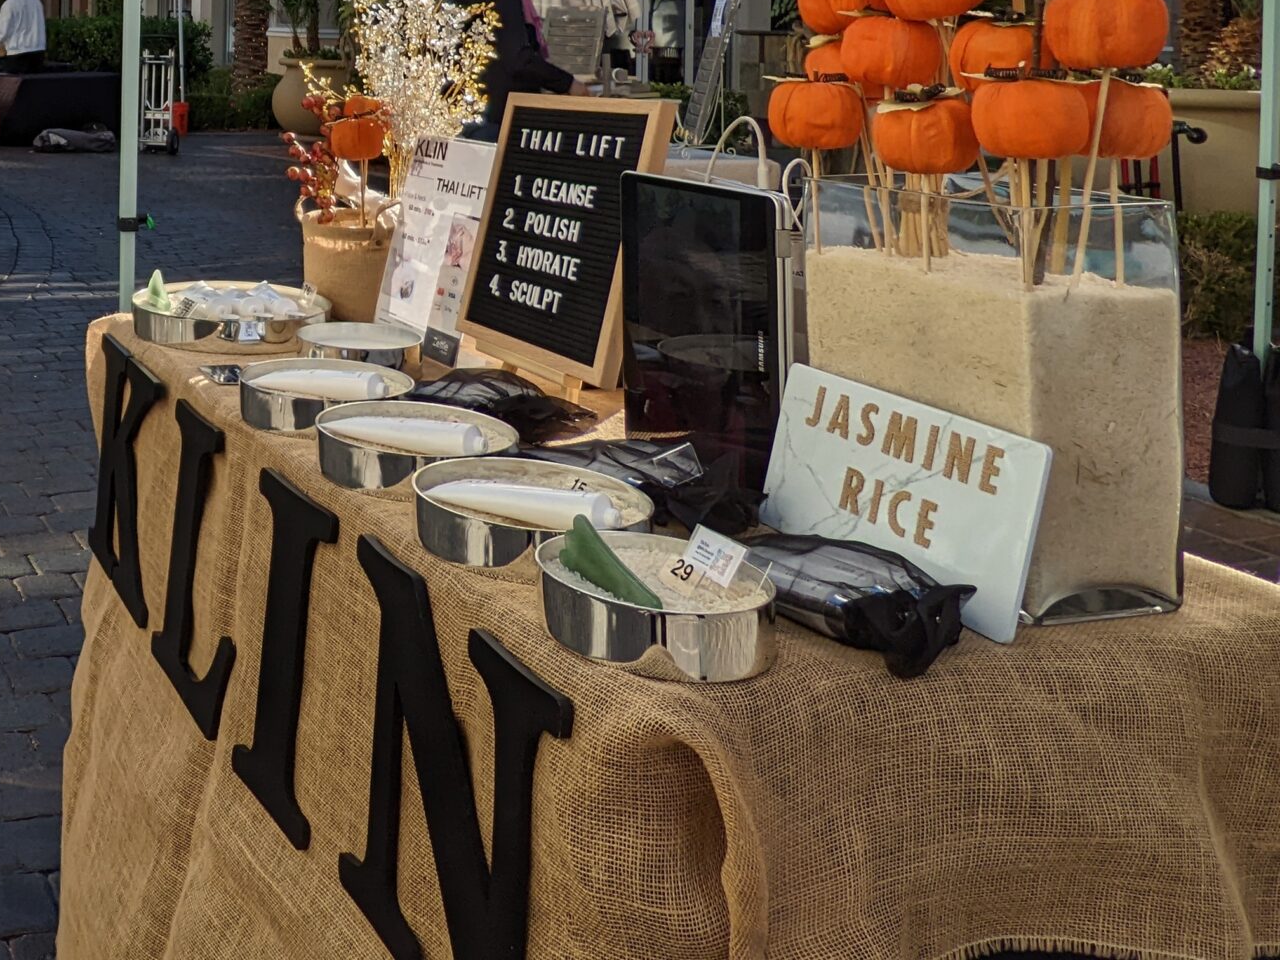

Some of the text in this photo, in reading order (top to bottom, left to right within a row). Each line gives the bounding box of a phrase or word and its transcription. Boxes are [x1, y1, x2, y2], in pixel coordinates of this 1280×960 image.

[414, 139, 448, 161] KLIN
[520, 128, 626, 159] THAI LIFT
[436, 178, 483, 200] THAI LIFT
[531, 177, 598, 208] CLEANSE
[523, 211, 581, 243] POLISH
[516, 245, 581, 281] HYDRATE
[508, 279, 563, 314] SCULPT
[805, 386, 1005, 495] JASMINE
[838, 465, 938, 549] RICE
[670, 558, 694, 581] 29
